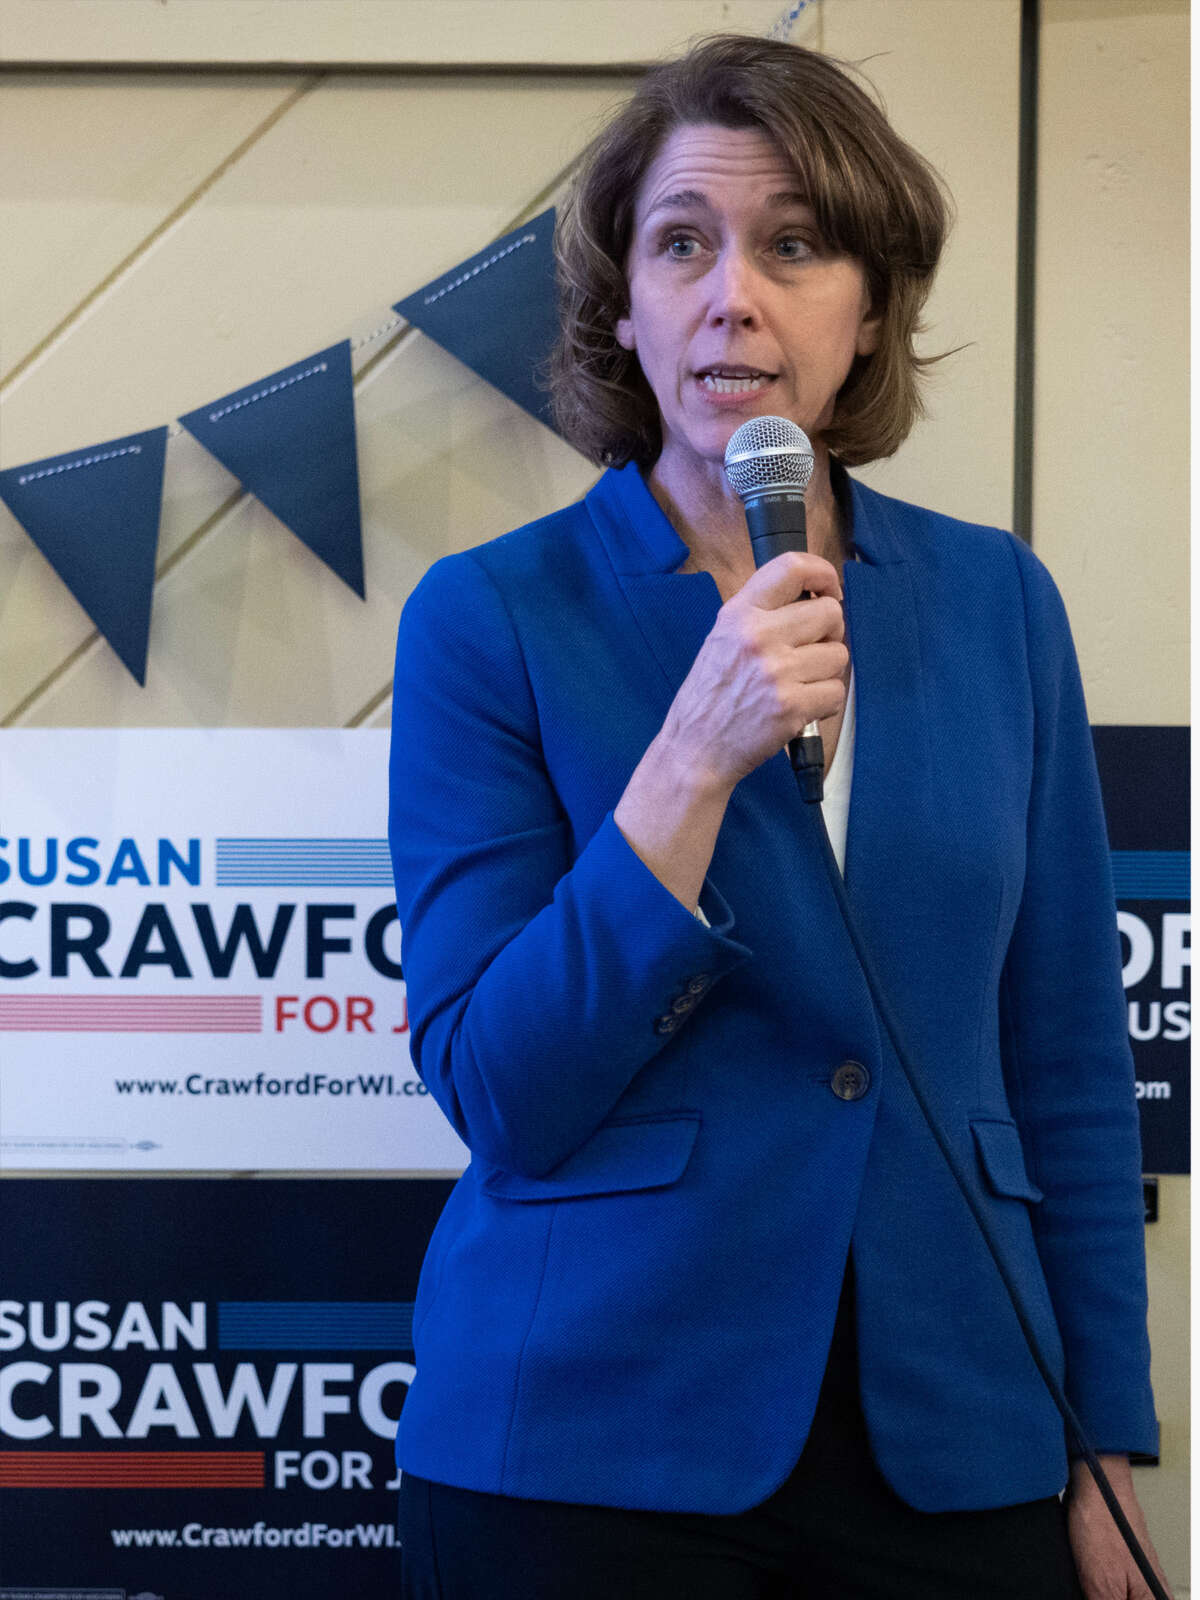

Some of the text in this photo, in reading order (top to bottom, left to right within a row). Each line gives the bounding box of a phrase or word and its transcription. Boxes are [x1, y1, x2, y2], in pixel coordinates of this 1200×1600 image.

[0, 838, 201, 887] USAN
[275, 995, 375, 1033] FOR
[0, 1301, 207, 1351] SUSAN
[274, 1450, 373, 1490] FOR
